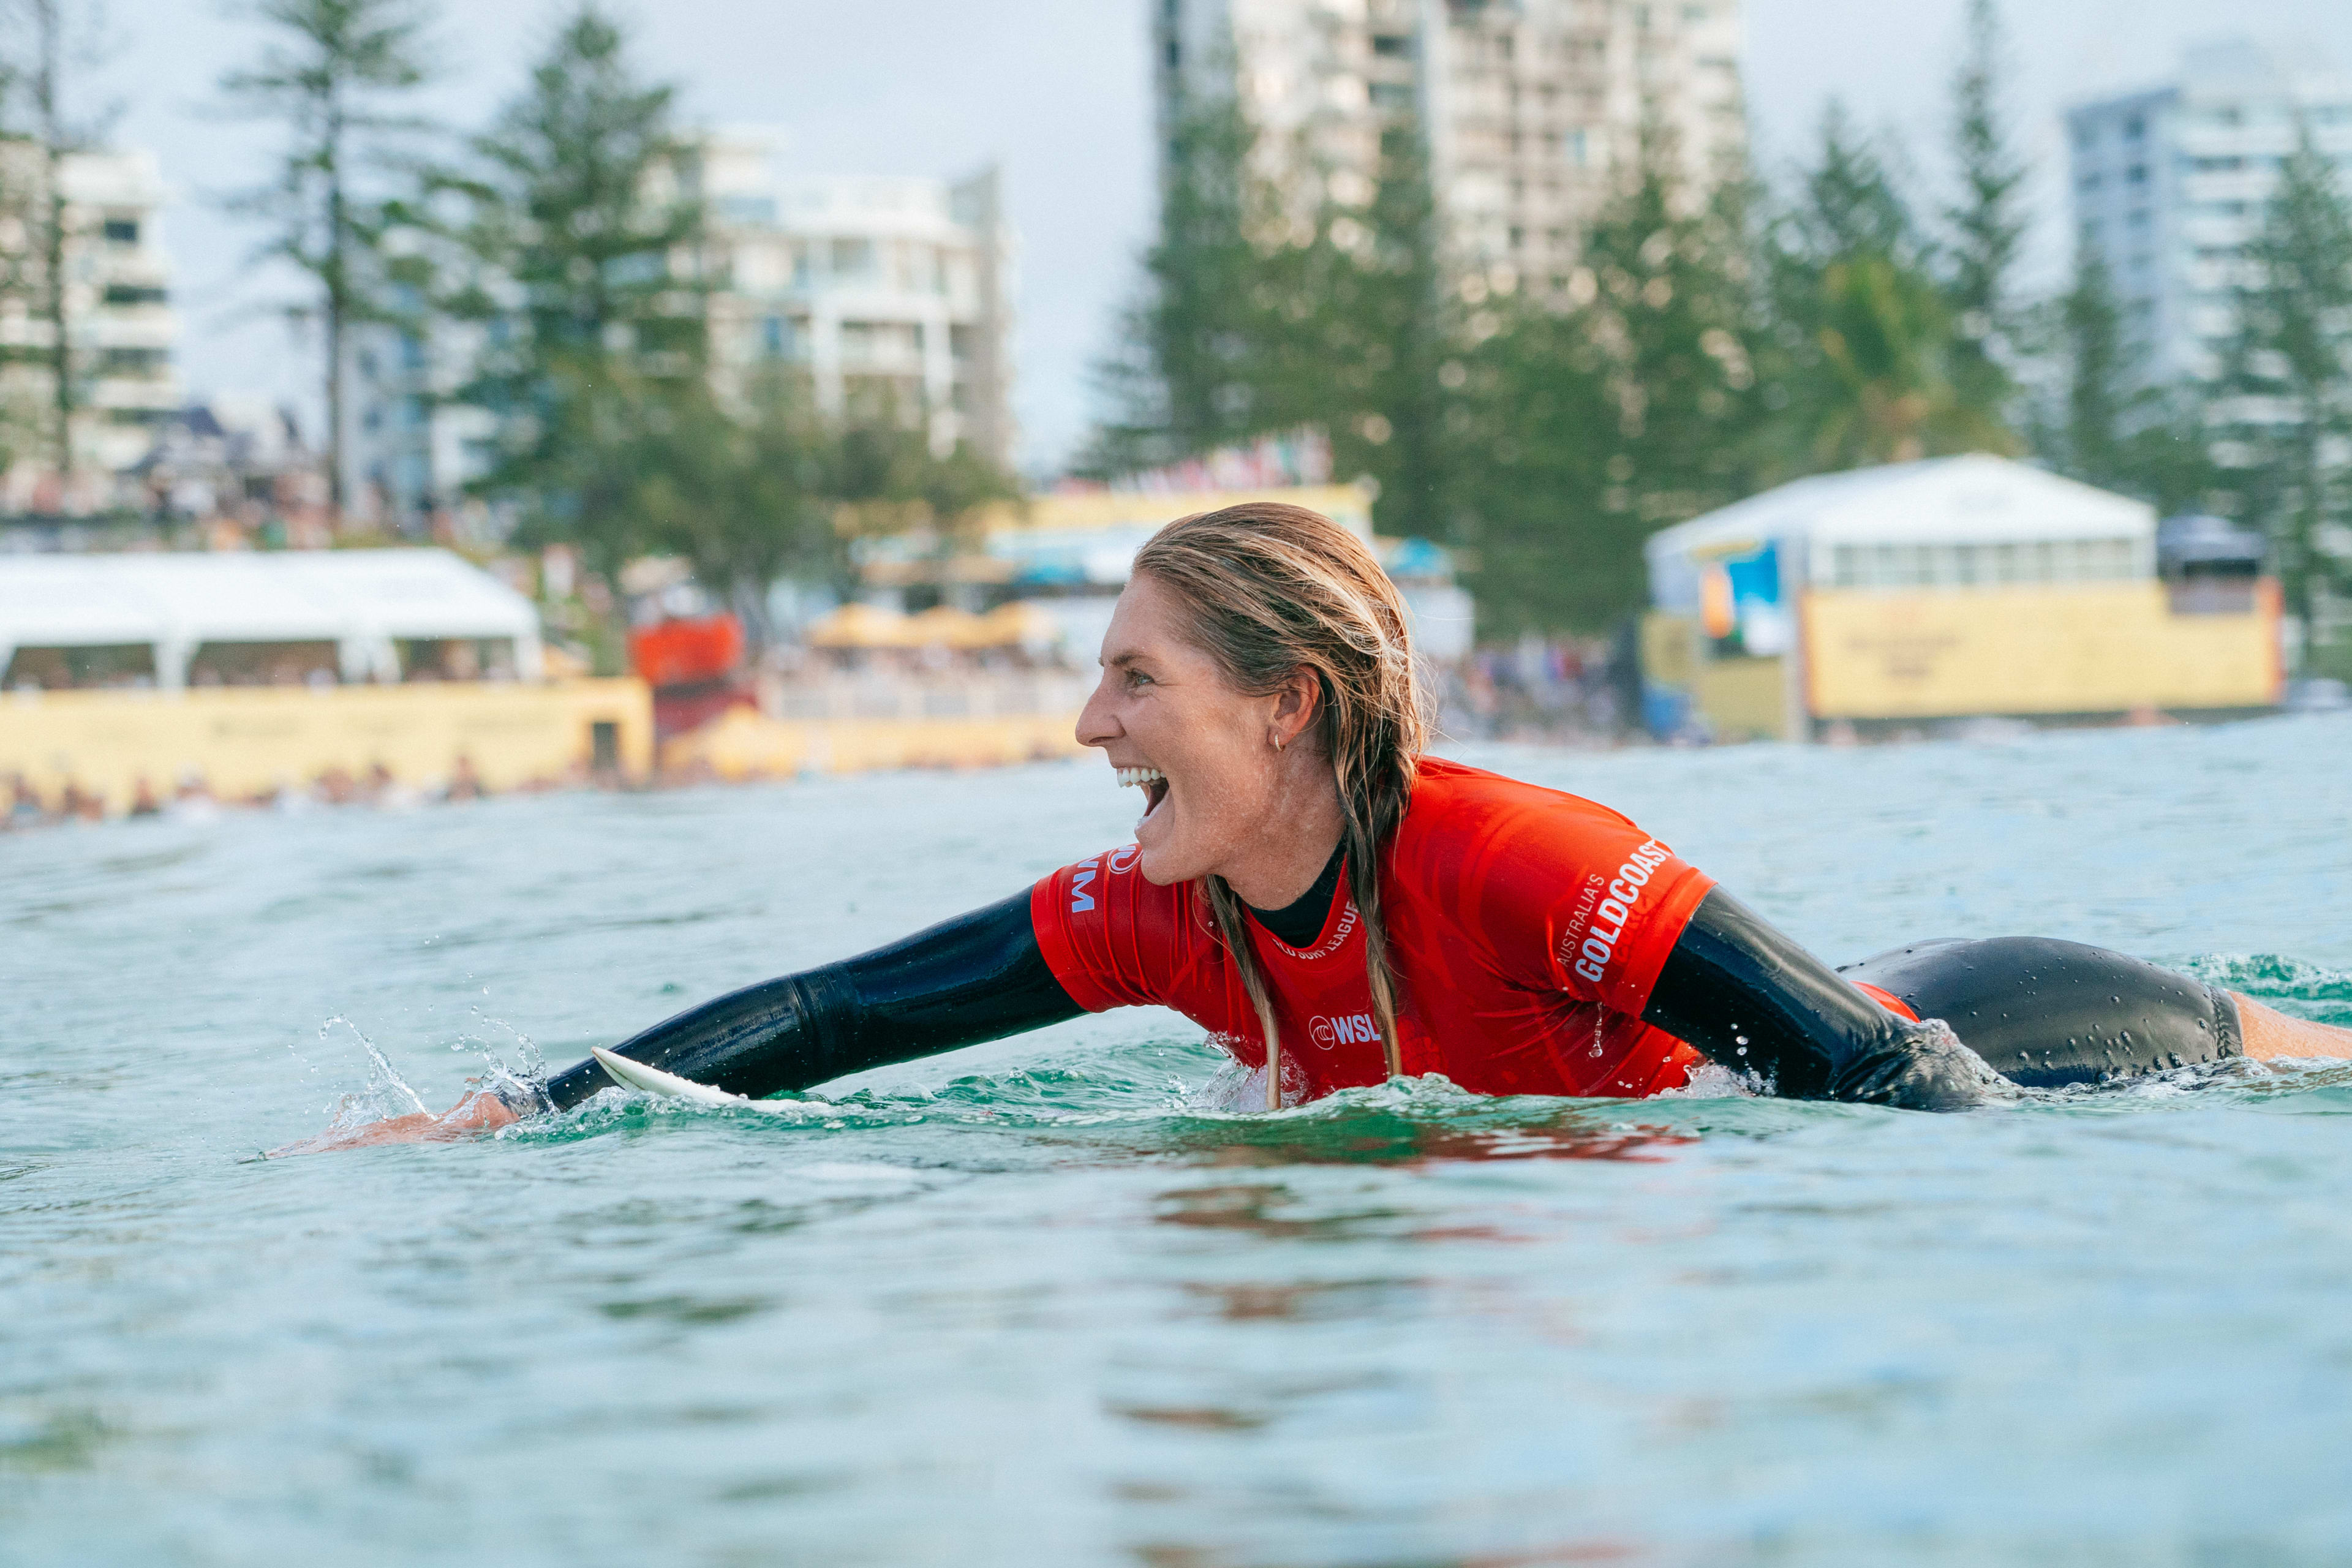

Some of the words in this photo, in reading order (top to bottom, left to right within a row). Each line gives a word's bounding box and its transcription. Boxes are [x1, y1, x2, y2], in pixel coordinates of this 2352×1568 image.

[1556, 873, 1605, 968] AUSTRALIA'S
[1575, 839, 1675, 982] GOLDCOAST
[1330, 1013, 1382, 1045] WSL
